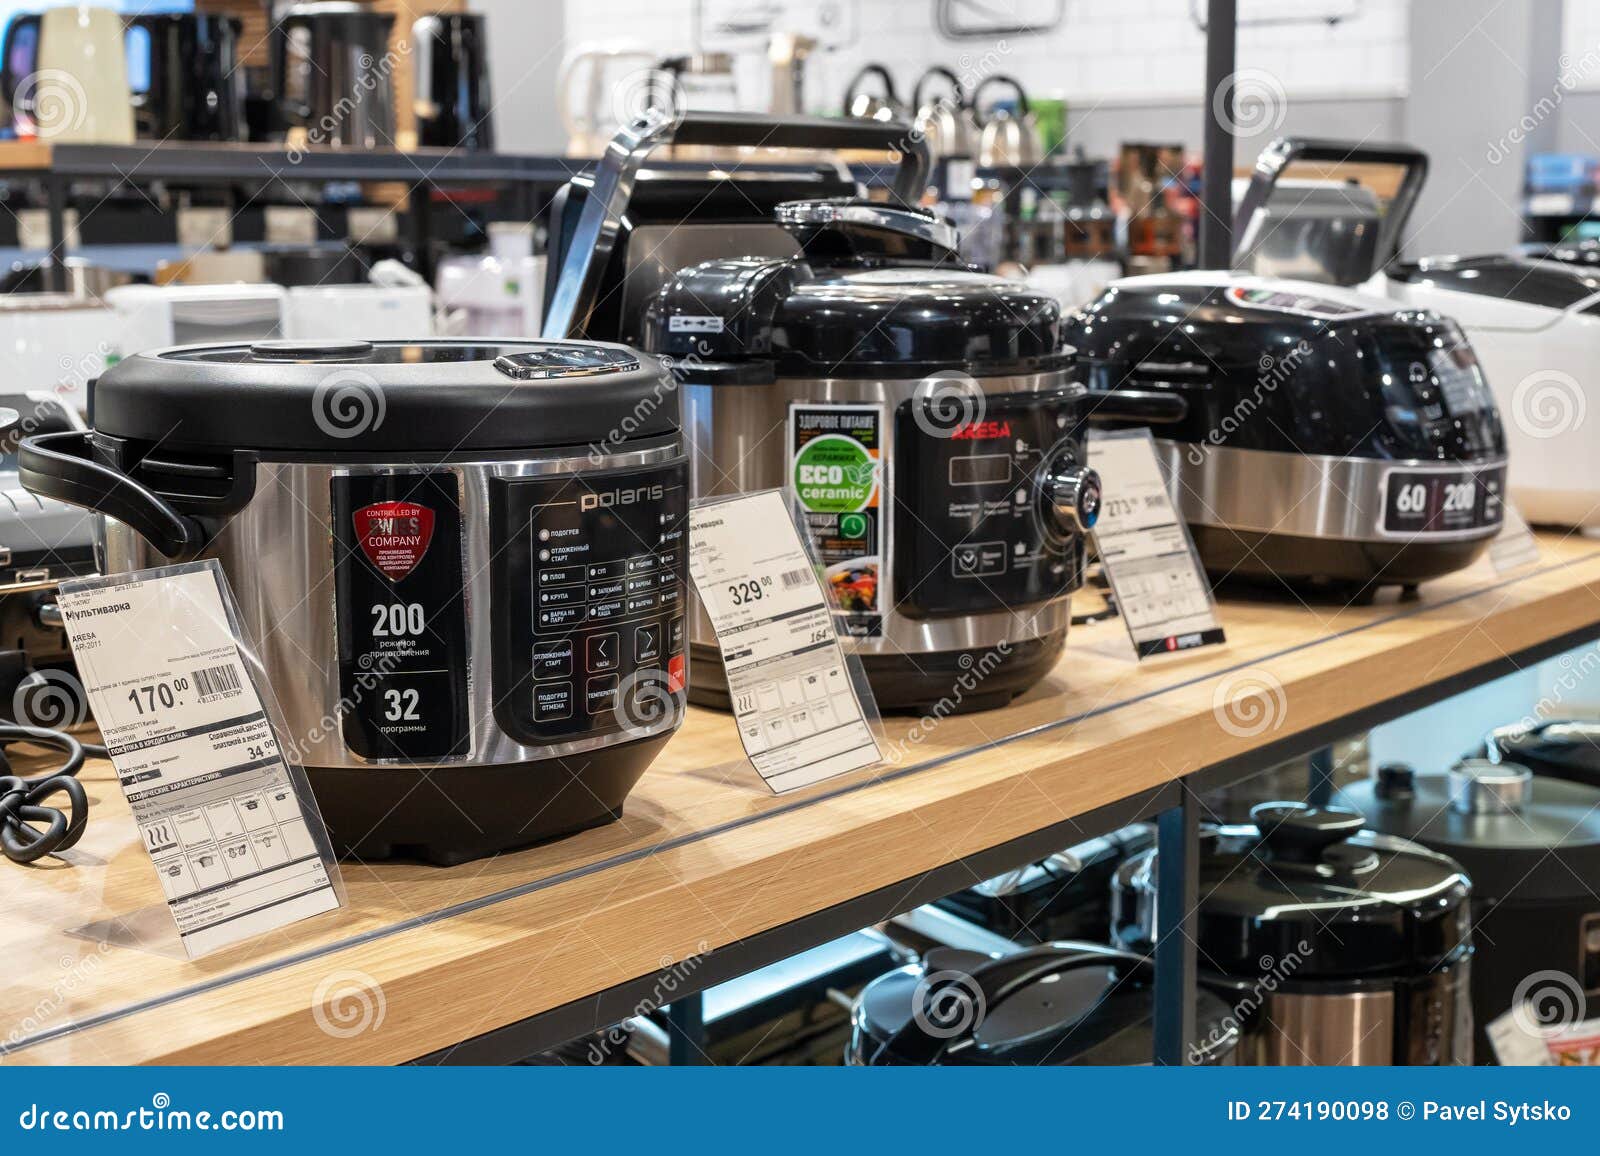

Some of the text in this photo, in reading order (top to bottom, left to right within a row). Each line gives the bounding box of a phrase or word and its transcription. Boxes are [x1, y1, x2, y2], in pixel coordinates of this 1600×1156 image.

[951, 422, 1012, 440] ARESA
[799, 464, 843, 485] ECO
[580, 484, 664, 513] polaris
[802, 485, 865, 499] ceramic
[1396, 483, 1427, 513] 60
[1442, 483, 1476, 511] 200
[366, 509, 410, 517] CONTROLLED
[368, 536, 421, 547] COMPANY
[65, 602, 131, 621] Мультиварка
[371, 603, 425, 636] 200
[72, 632, 97, 643] ARESA
[380, 640, 416, 649] режимов
[370, 648, 430, 658] приготовления
[538, 691, 568, 701] ПОДОГРЕВ
[384, 688, 421, 721] 32
[541, 703, 565, 711] ОТМЕНА
[380, 725, 427, 734] программы
